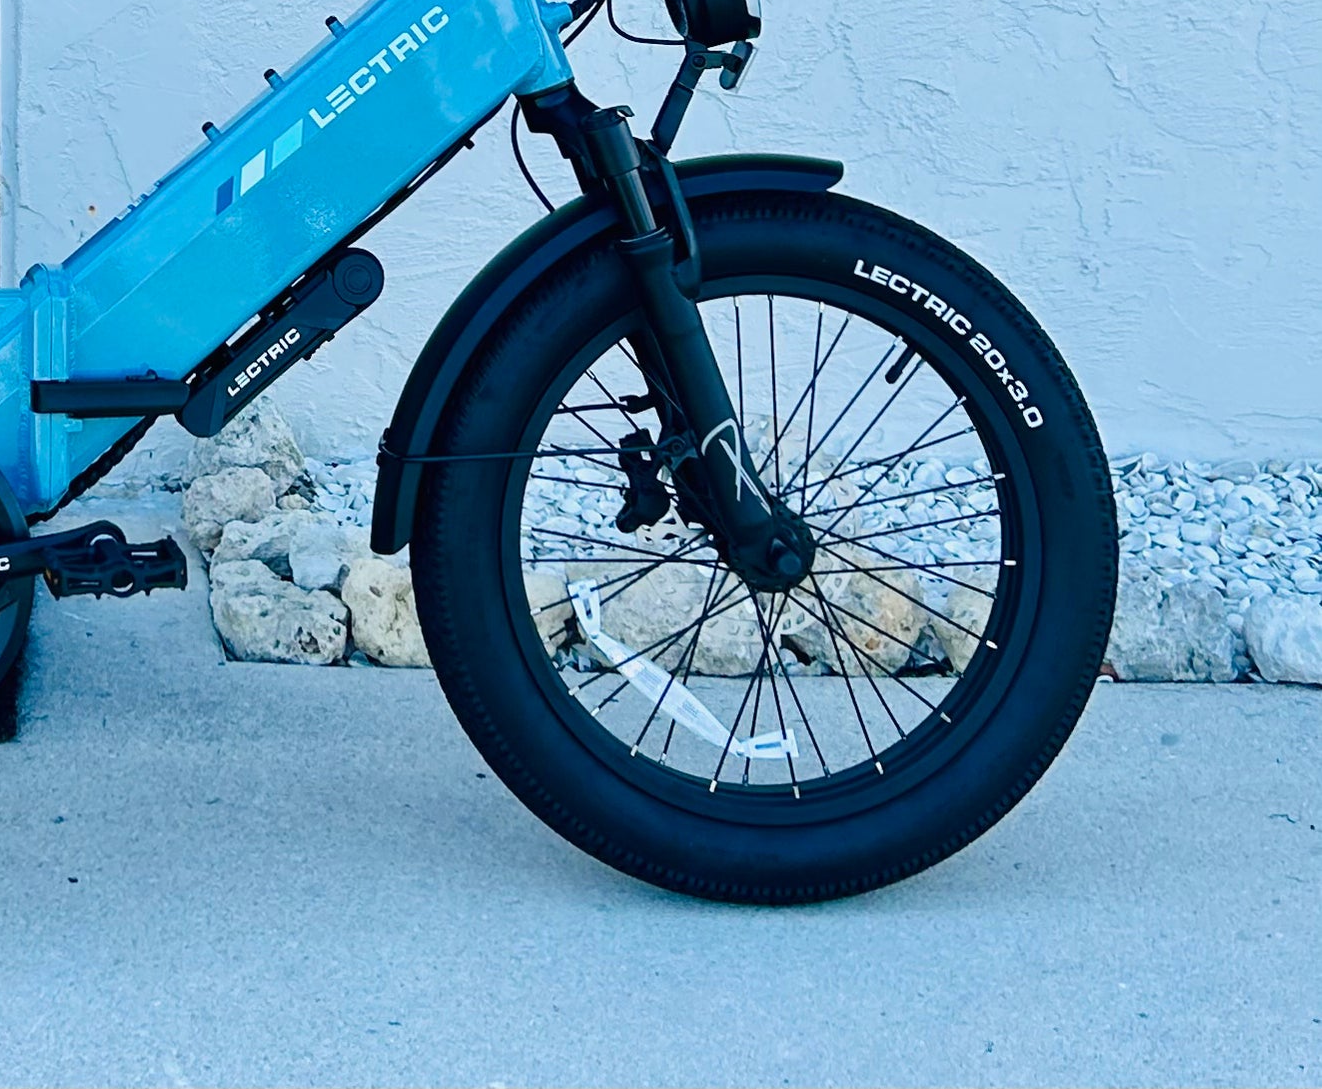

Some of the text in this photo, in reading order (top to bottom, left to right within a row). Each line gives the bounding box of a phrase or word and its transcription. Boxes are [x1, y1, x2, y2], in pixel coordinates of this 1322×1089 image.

[308, 4, 450, 130] LECTRIC
[226, 327, 302, 398] LECTRIC
[853, 258, 1045, 430] LECTRIC 20x3.0
